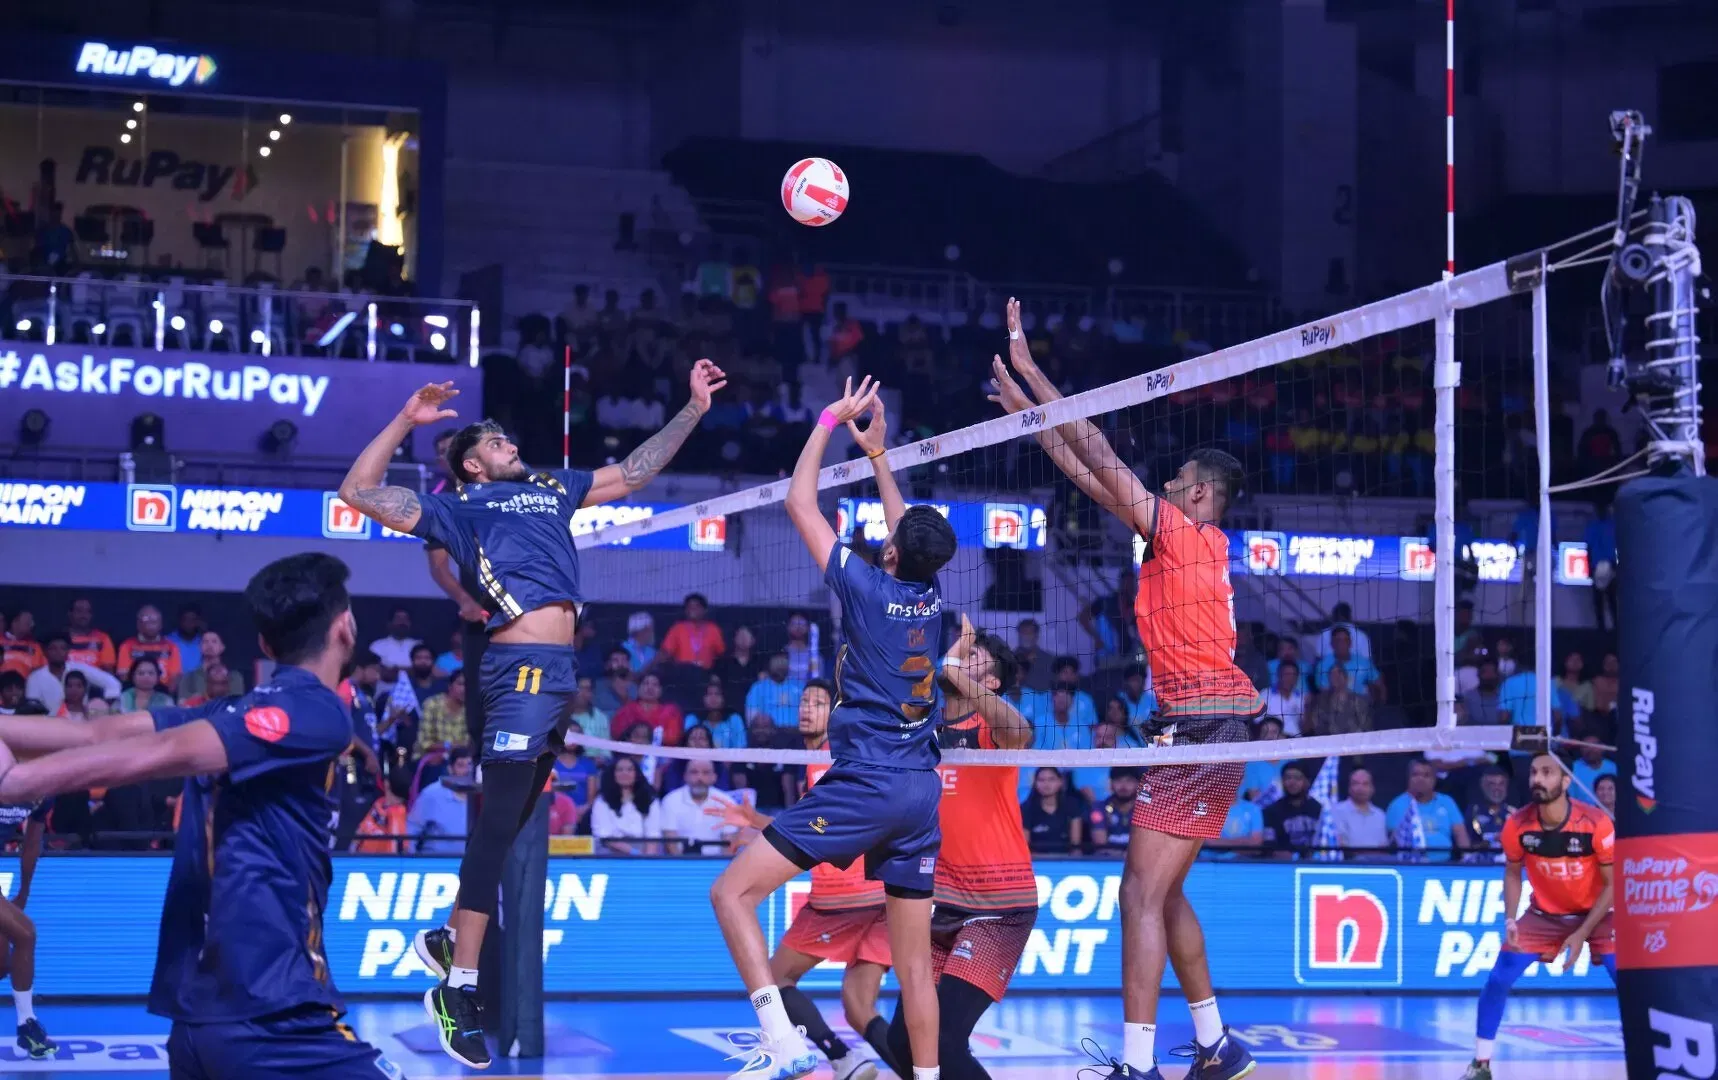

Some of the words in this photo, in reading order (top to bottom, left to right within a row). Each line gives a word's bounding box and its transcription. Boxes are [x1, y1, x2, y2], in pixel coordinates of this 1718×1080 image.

[76, 42, 199, 86] RuPay
[75, 146, 235, 202] RuPay
[1301, 325, 1331, 347] RuPay
[0, 350, 329, 416] #AskForRuPay
[181, 489, 284, 513] NIPPON
[187, 509, 267, 531] PAINT
[515, 666, 542, 694] 11
[1632, 687, 1657, 799] RuPay
[1623, 857, 1677, 876] RuPay
[339, 872, 609, 920] NIPN
[1624, 878, 1689, 902] Prime
[1626, 900, 1686, 916] Volleyball
